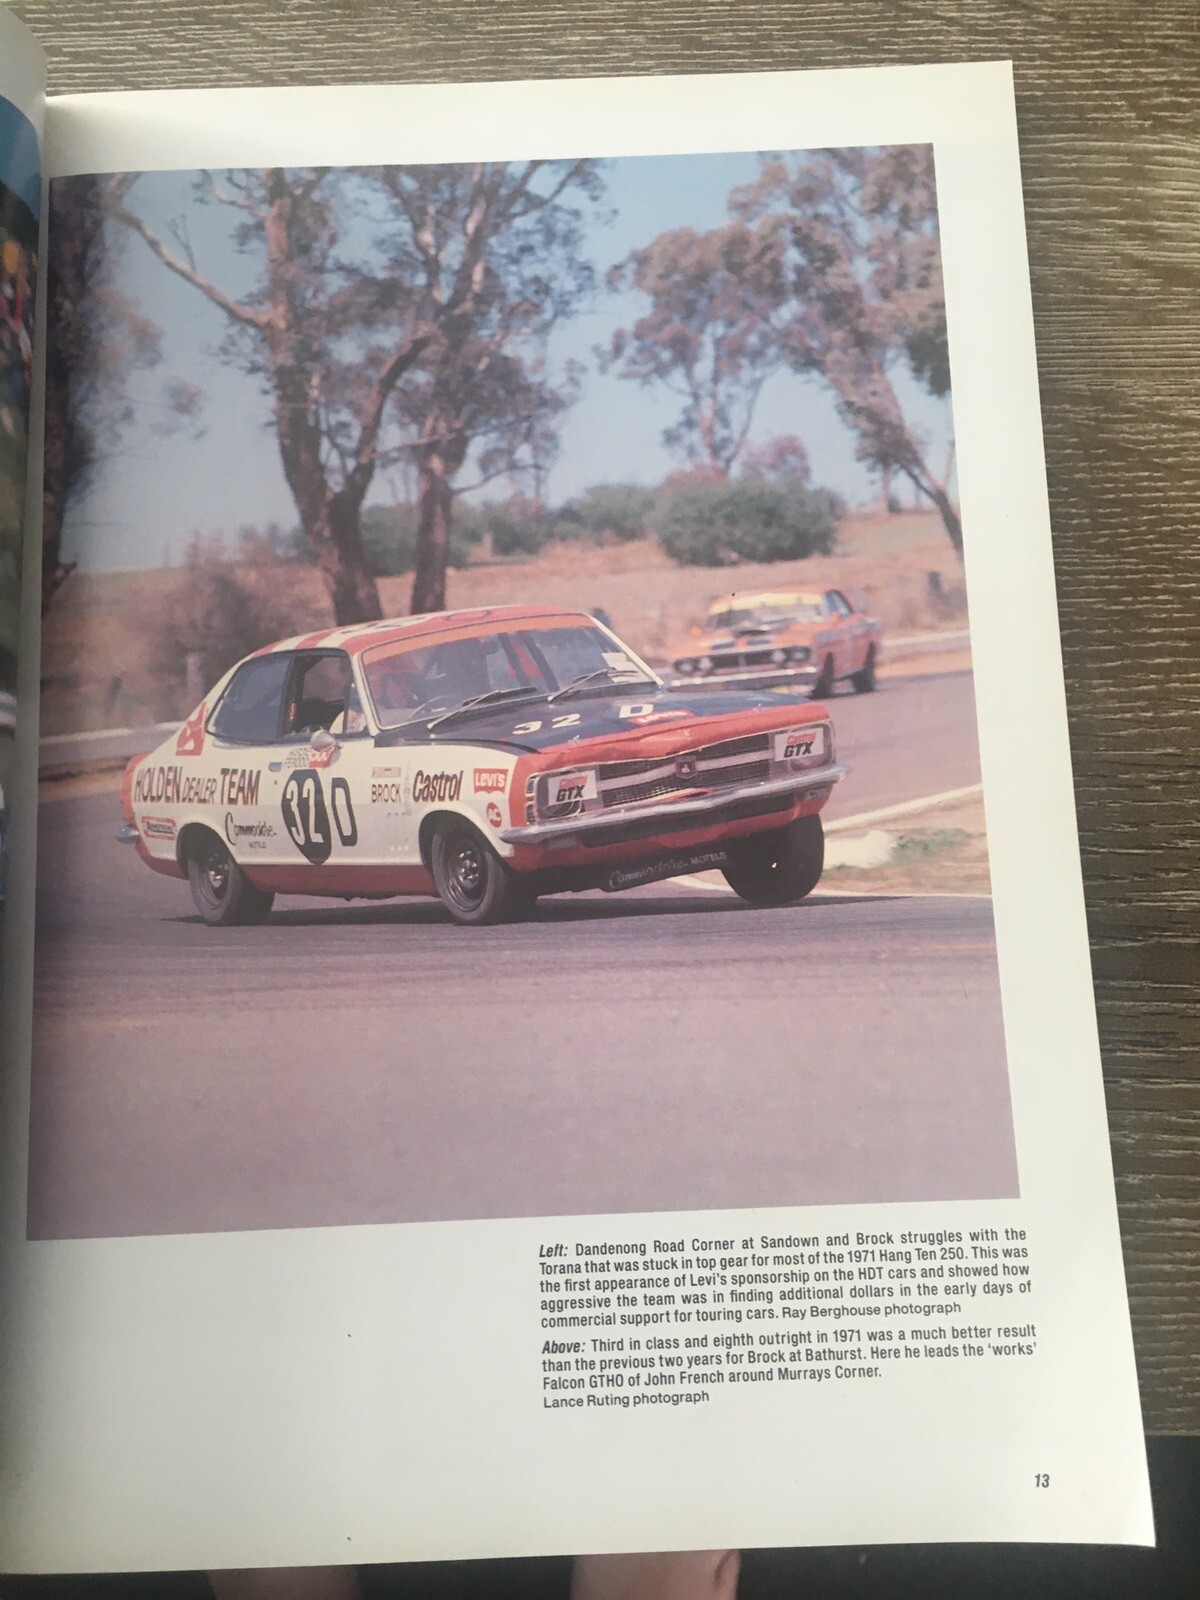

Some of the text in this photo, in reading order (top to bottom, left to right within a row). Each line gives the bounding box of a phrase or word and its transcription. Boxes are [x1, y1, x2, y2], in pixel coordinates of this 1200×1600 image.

[784, 741, 814, 759] GTX
[134, 766, 261, 806] HOLDEN DEALER TEAM
[371, 783, 402, 803] BROCK
[412, 769, 464, 803] Castrol
[556, 784, 586, 803] GTX
[286, 777, 325, 846] 32
[690, 851, 728, 866] MOTELS
[539, 1228, 1026, 1258] Left: Dandenong Road Corner at Sandown and Brock struggles with the
[539, 1246, 1028, 1275] Torana that was stuck in top gear for most of the 1971 Hang Ten 250. This was
[540, 1280, 560, 1292] the
[564, 1278, 591, 1291] first
[595, 1277, 669, 1293] appearance
[674, 1274, 686, 1287] of
[731, 1270, 809, 1287] sponsorship
[814, 1271, 829, 1282] on
[833, 1268, 854, 1281] the
[858, 1267, 883, 1280] HDT
[888, 1268, 916, 1279] cars
[921, 1265, 944, 1278] and
[948, 1263, 998, 1277] showed
[1002, 1263, 1029, 1276] how
[541, 1280, 1031, 1313] aggressive the team was in finding additional dollars in the early days of
[541, 1302, 961, 1328] commercial support for touring cars. Ray Berghouse photograph
[541, 1324, 1036, 1354] Above: Third in class and eighth outright in 1971 was a much better result
[542, 1359, 571, 1372] than
[575, 1358, 596, 1371] the
[600, 1356, 655, 1372] previous
[659, 1355, 683, 1367] two
[687, 1355, 722, 1369] years
[725, 1351, 744, 1364] for
[748, 1350, 786, 1363] Brock
[789, 1349, 802, 1362] at
[805, 1347, 866, 1361] Bathurst.
[871, 1346, 901, 1359] Here
[905, 1345, 920, 1358] he
[924, 1344, 959, 1358] leads
[962, 1344, 984, 1356] the
[543, 1365, 881, 1390] Falcon GTHO of John French around Murrays Corner.
[544, 1390, 709, 1408] Lance Ruting photograph
[1035, 1474, 1050, 1488] 13
